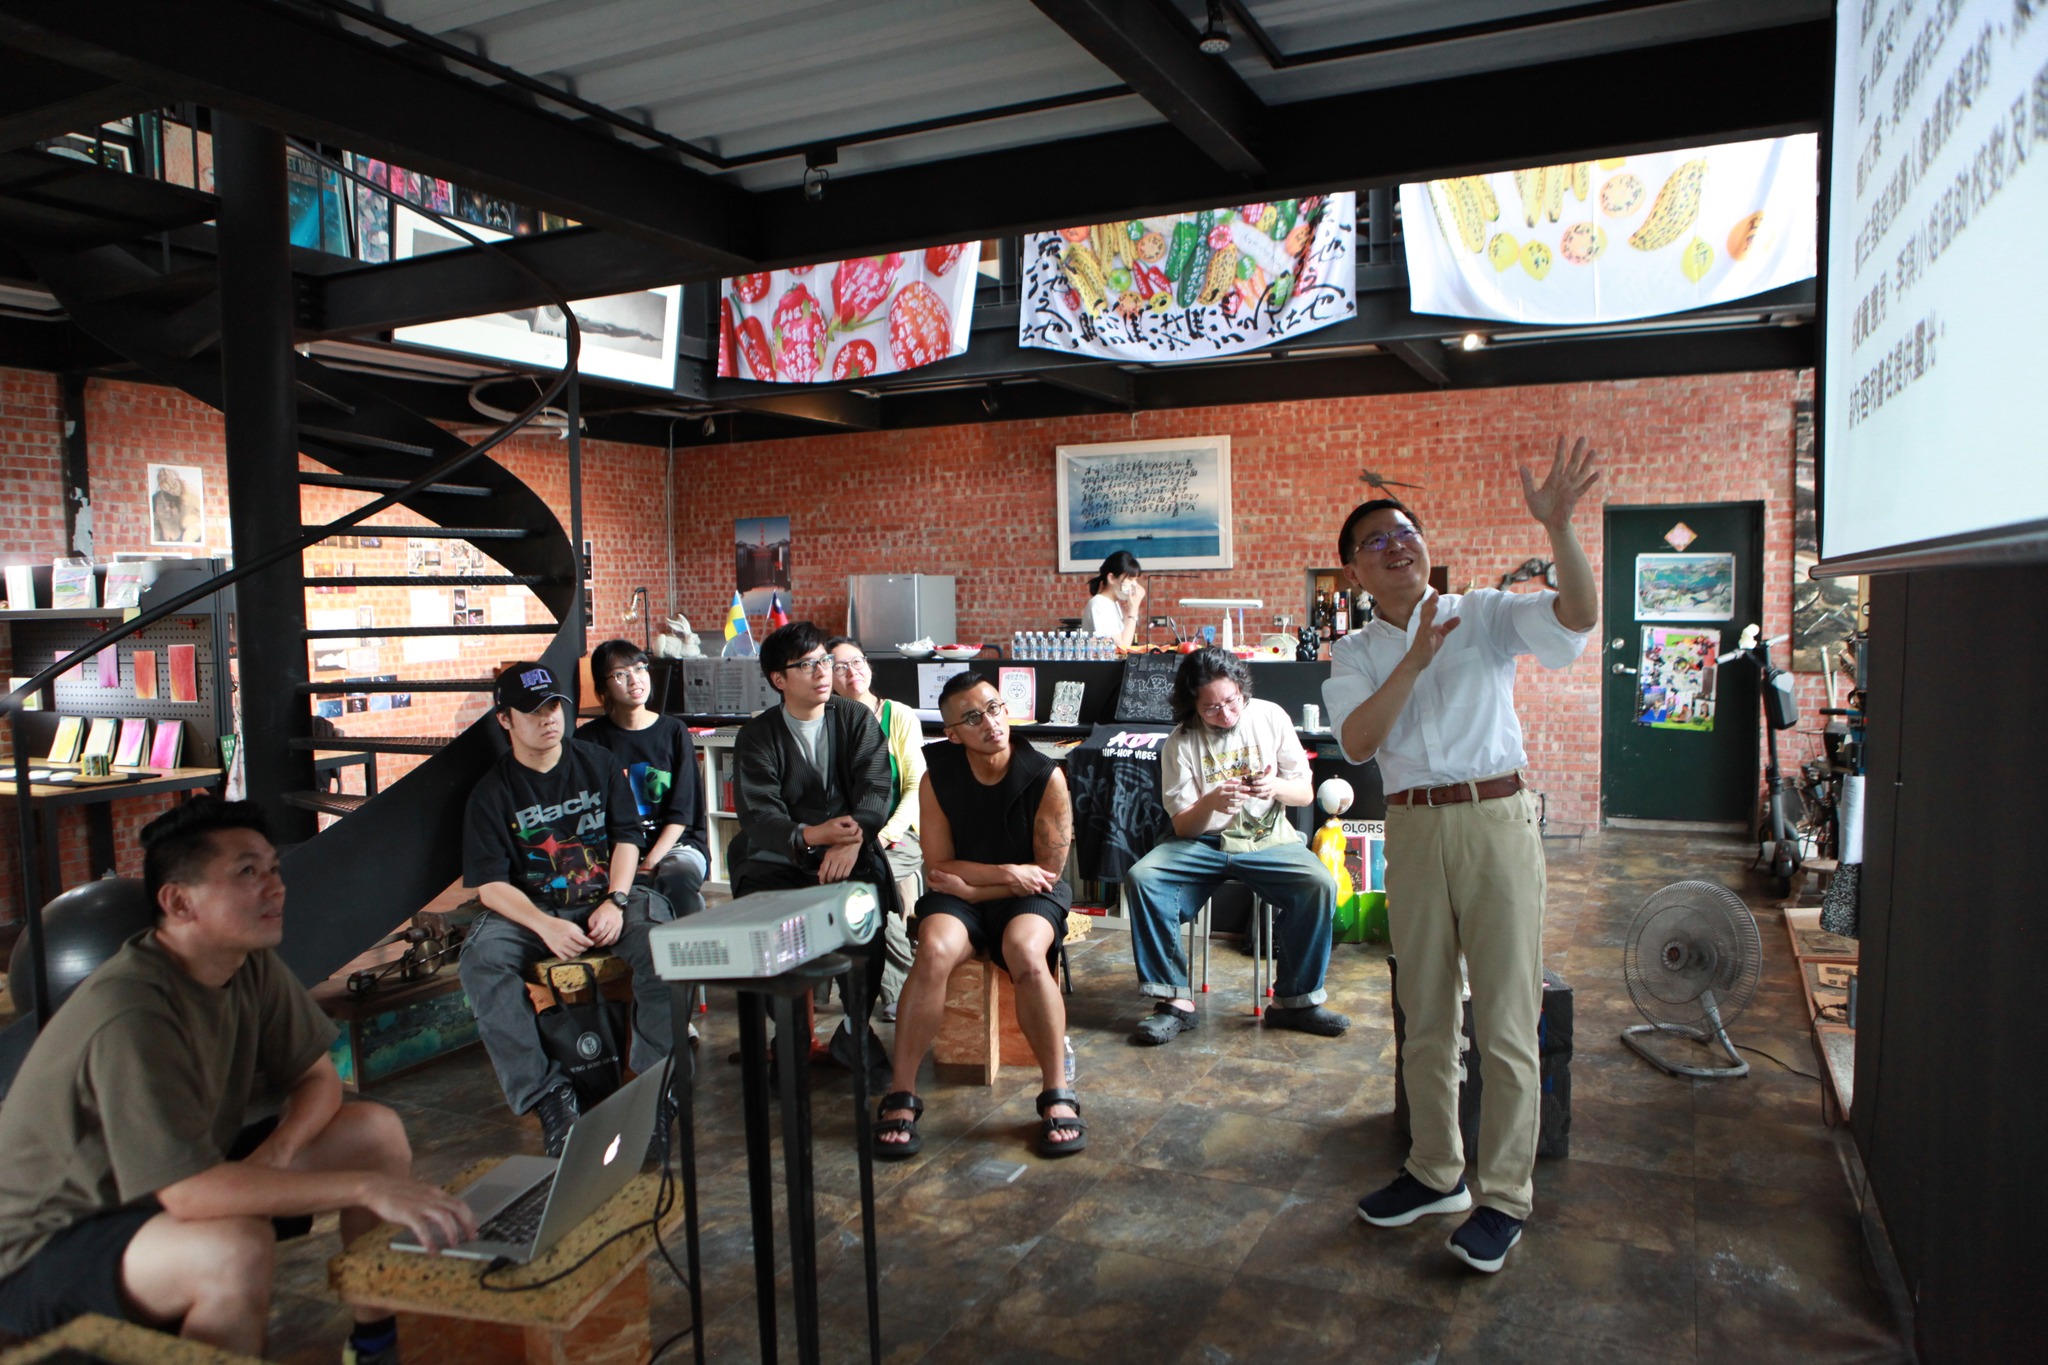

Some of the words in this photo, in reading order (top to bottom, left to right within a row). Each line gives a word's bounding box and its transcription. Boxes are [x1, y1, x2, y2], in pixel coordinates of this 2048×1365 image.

[1102, 748, 1134, 758] HIP-HOP
[1134, 749, 1157, 761] VIBES
[516, 790, 602, 831] Black
[1342, 822, 1384, 835] OLORS
